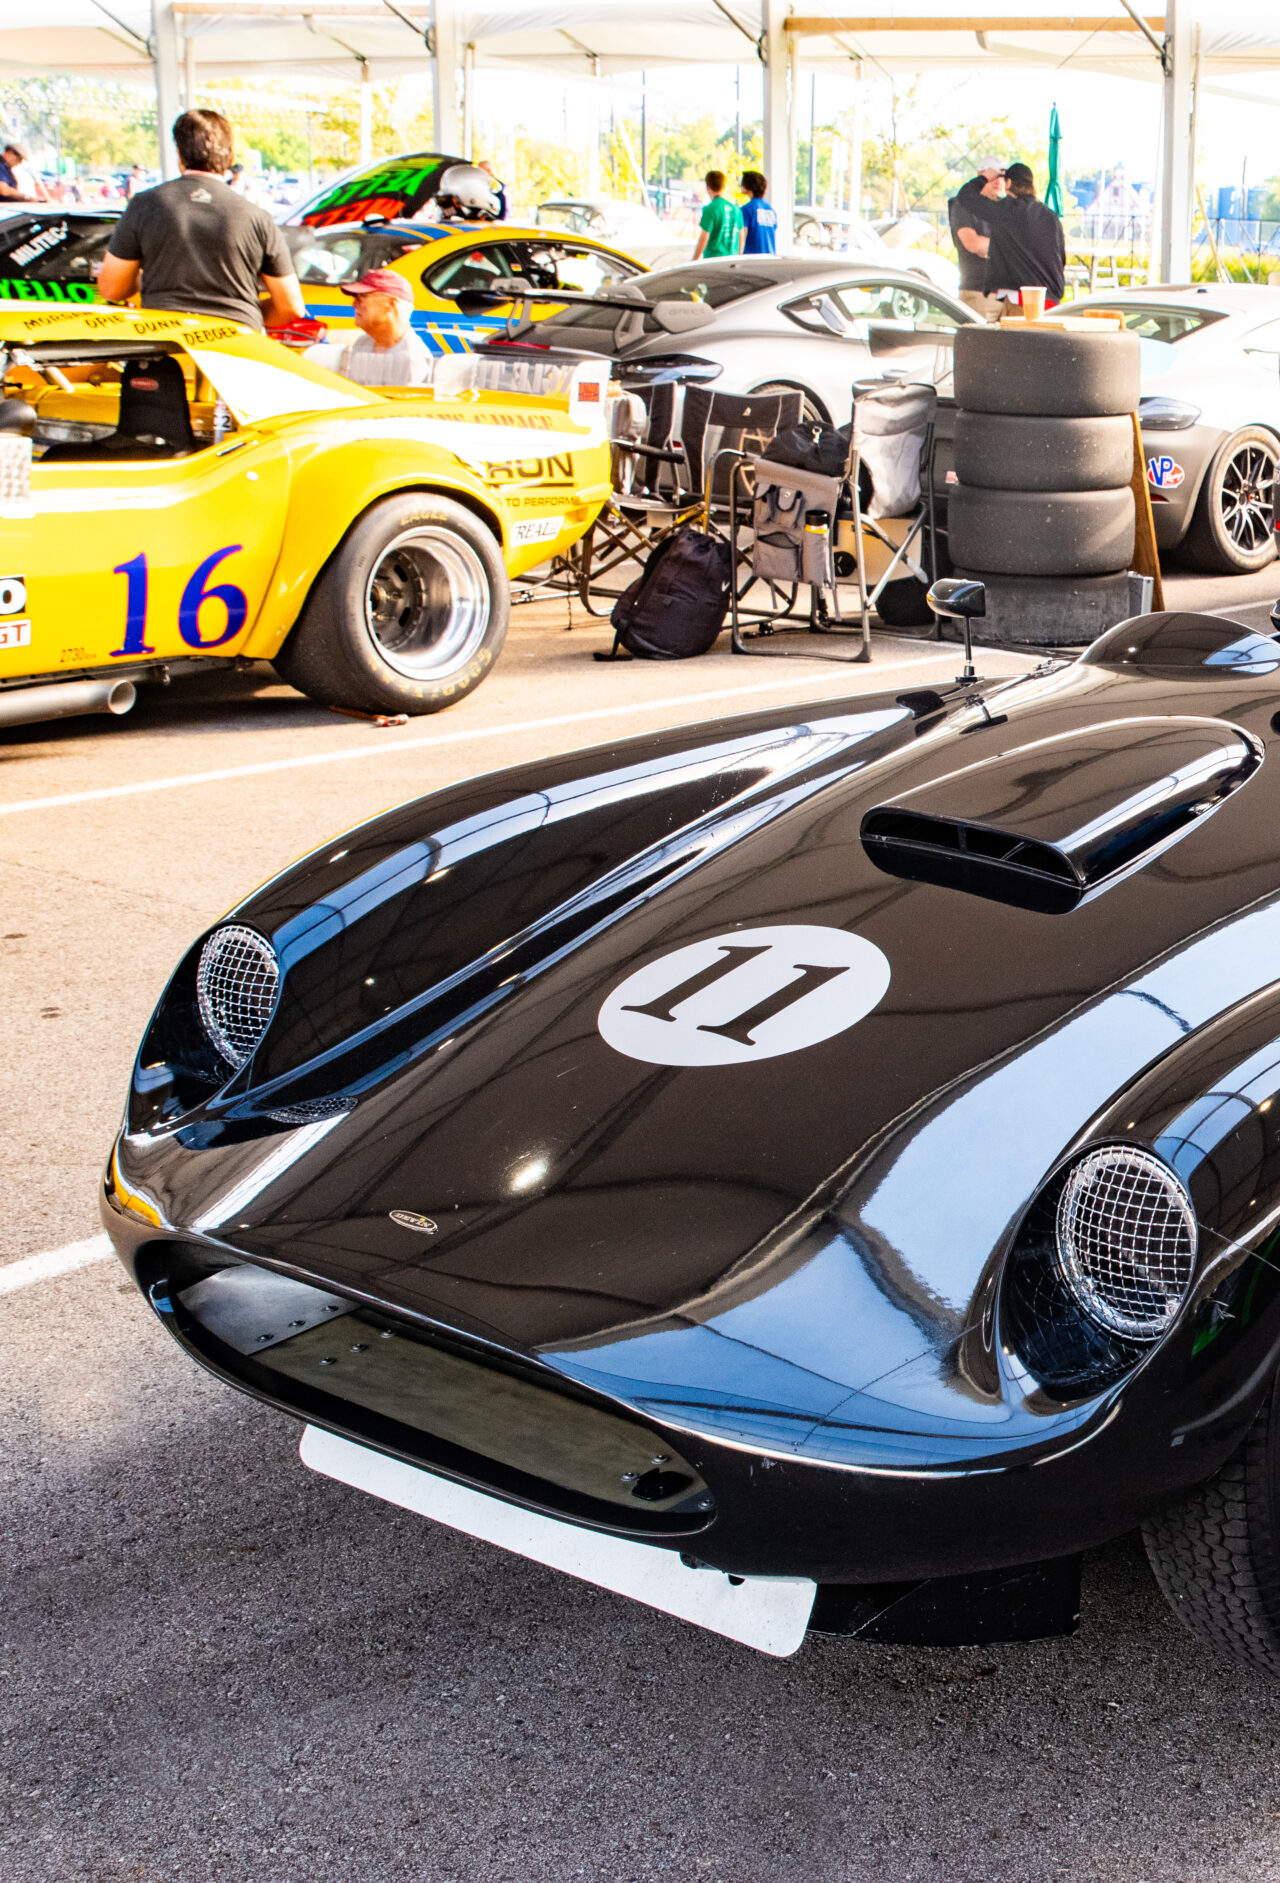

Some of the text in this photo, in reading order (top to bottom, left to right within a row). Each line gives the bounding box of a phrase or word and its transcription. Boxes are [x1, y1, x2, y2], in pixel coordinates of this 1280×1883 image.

[0, 278, 95, 304] YELLO
[133, 319, 182, 335] DUNN
[109, 543, 249, 658] 16
[620, 945, 850, 1046] 11
